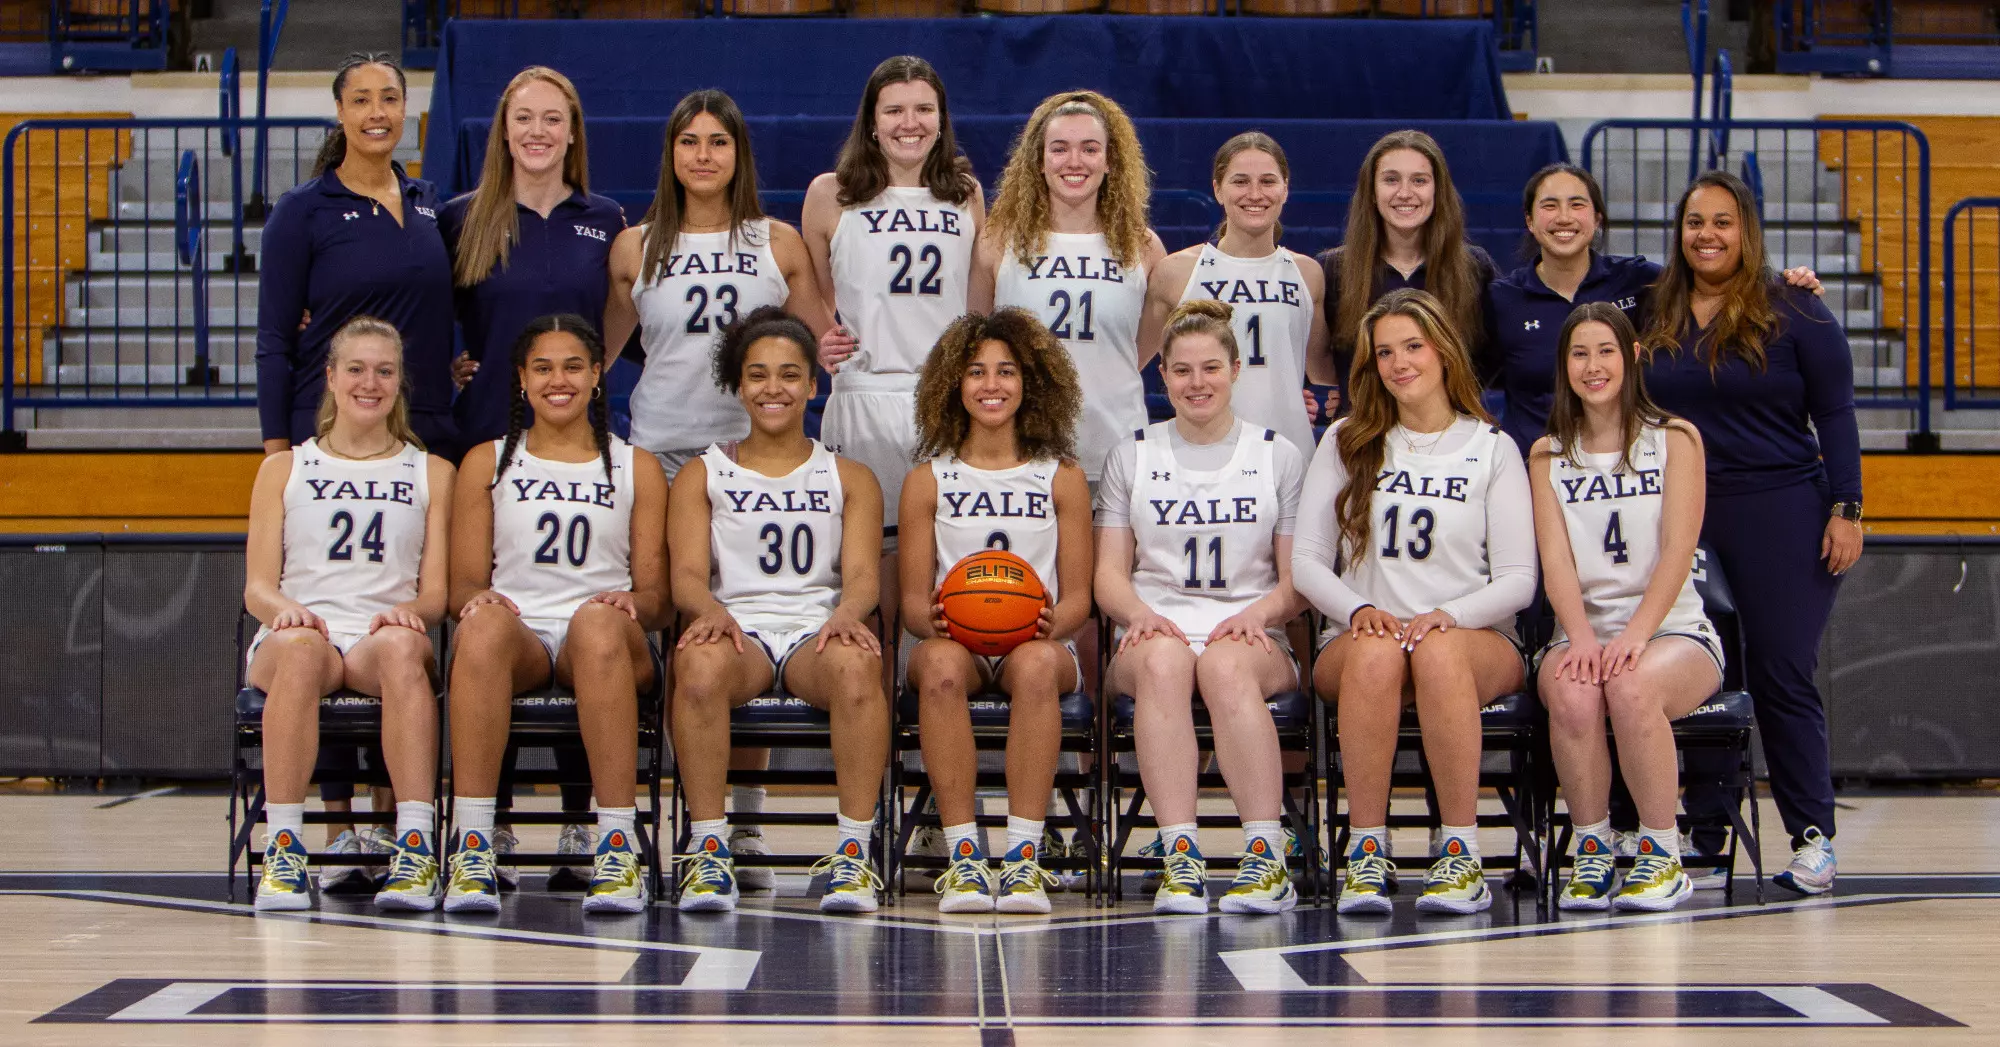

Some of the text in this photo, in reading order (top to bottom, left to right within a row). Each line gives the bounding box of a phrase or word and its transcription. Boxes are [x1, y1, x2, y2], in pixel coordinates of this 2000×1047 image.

[574, 225, 606, 241] YALE
[860, 209, 961, 236] YALE
[660, 252, 758, 278] YALE
[889, 244, 942, 296] 22
[1028, 256, 1124, 284] YALE
[1200, 279, 1300, 307] YALE
[684, 285, 738, 334] 23
[1049, 290, 1095, 341] 21
[1247, 314, 1266, 366] 1
[306, 479, 414, 506] YALE
[511, 478, 614, 510] YALE
[1560, 468, 1662, 504] YALE
[724, 489, 831, 514] YALE
[943, 491, 1049, 519] YALE
[1149, 497, 1257, 526] YALE
[328, 511, 385, 563] 24
[534, 512, 591, 566] 20
[1381, 505, 1435, 561] 13
[1603, 511, 1629, 565] 4
[758, 523, 814, 575] 30
[1184, 536, 1227, 589] 11
[967, 565, 1024, 582] ELITE
[335, 698, 382, 706] ARMOU
[548, 698, 577, 706] ARM
[746, 698, 780, 707] NDER
[968, 702, 994, 710] DER
